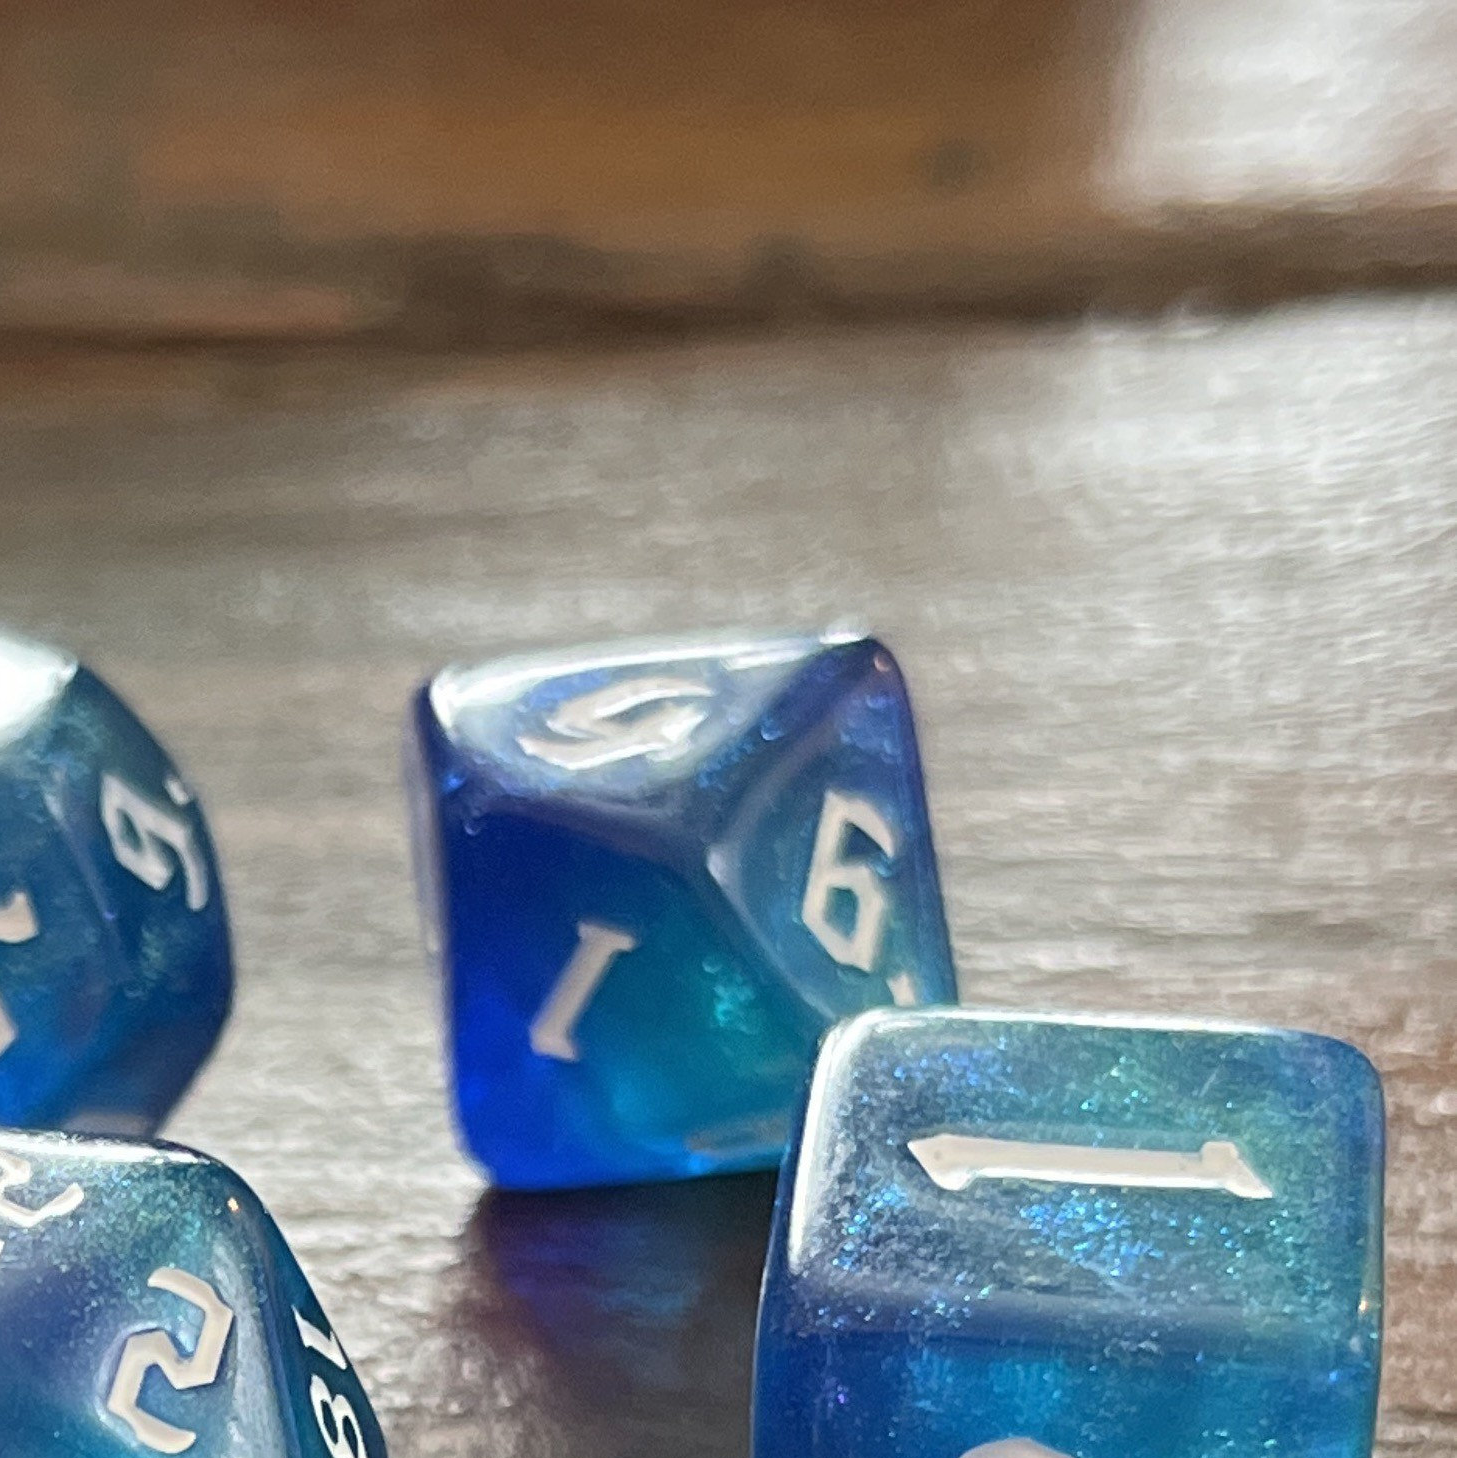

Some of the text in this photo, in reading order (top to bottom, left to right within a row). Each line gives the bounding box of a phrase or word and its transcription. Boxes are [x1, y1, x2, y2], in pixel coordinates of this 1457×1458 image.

[528, 919, 638, 1063] 1
[907, 1133, 1274, 1199] 1
[107, 1267, 234, 1454] 2
